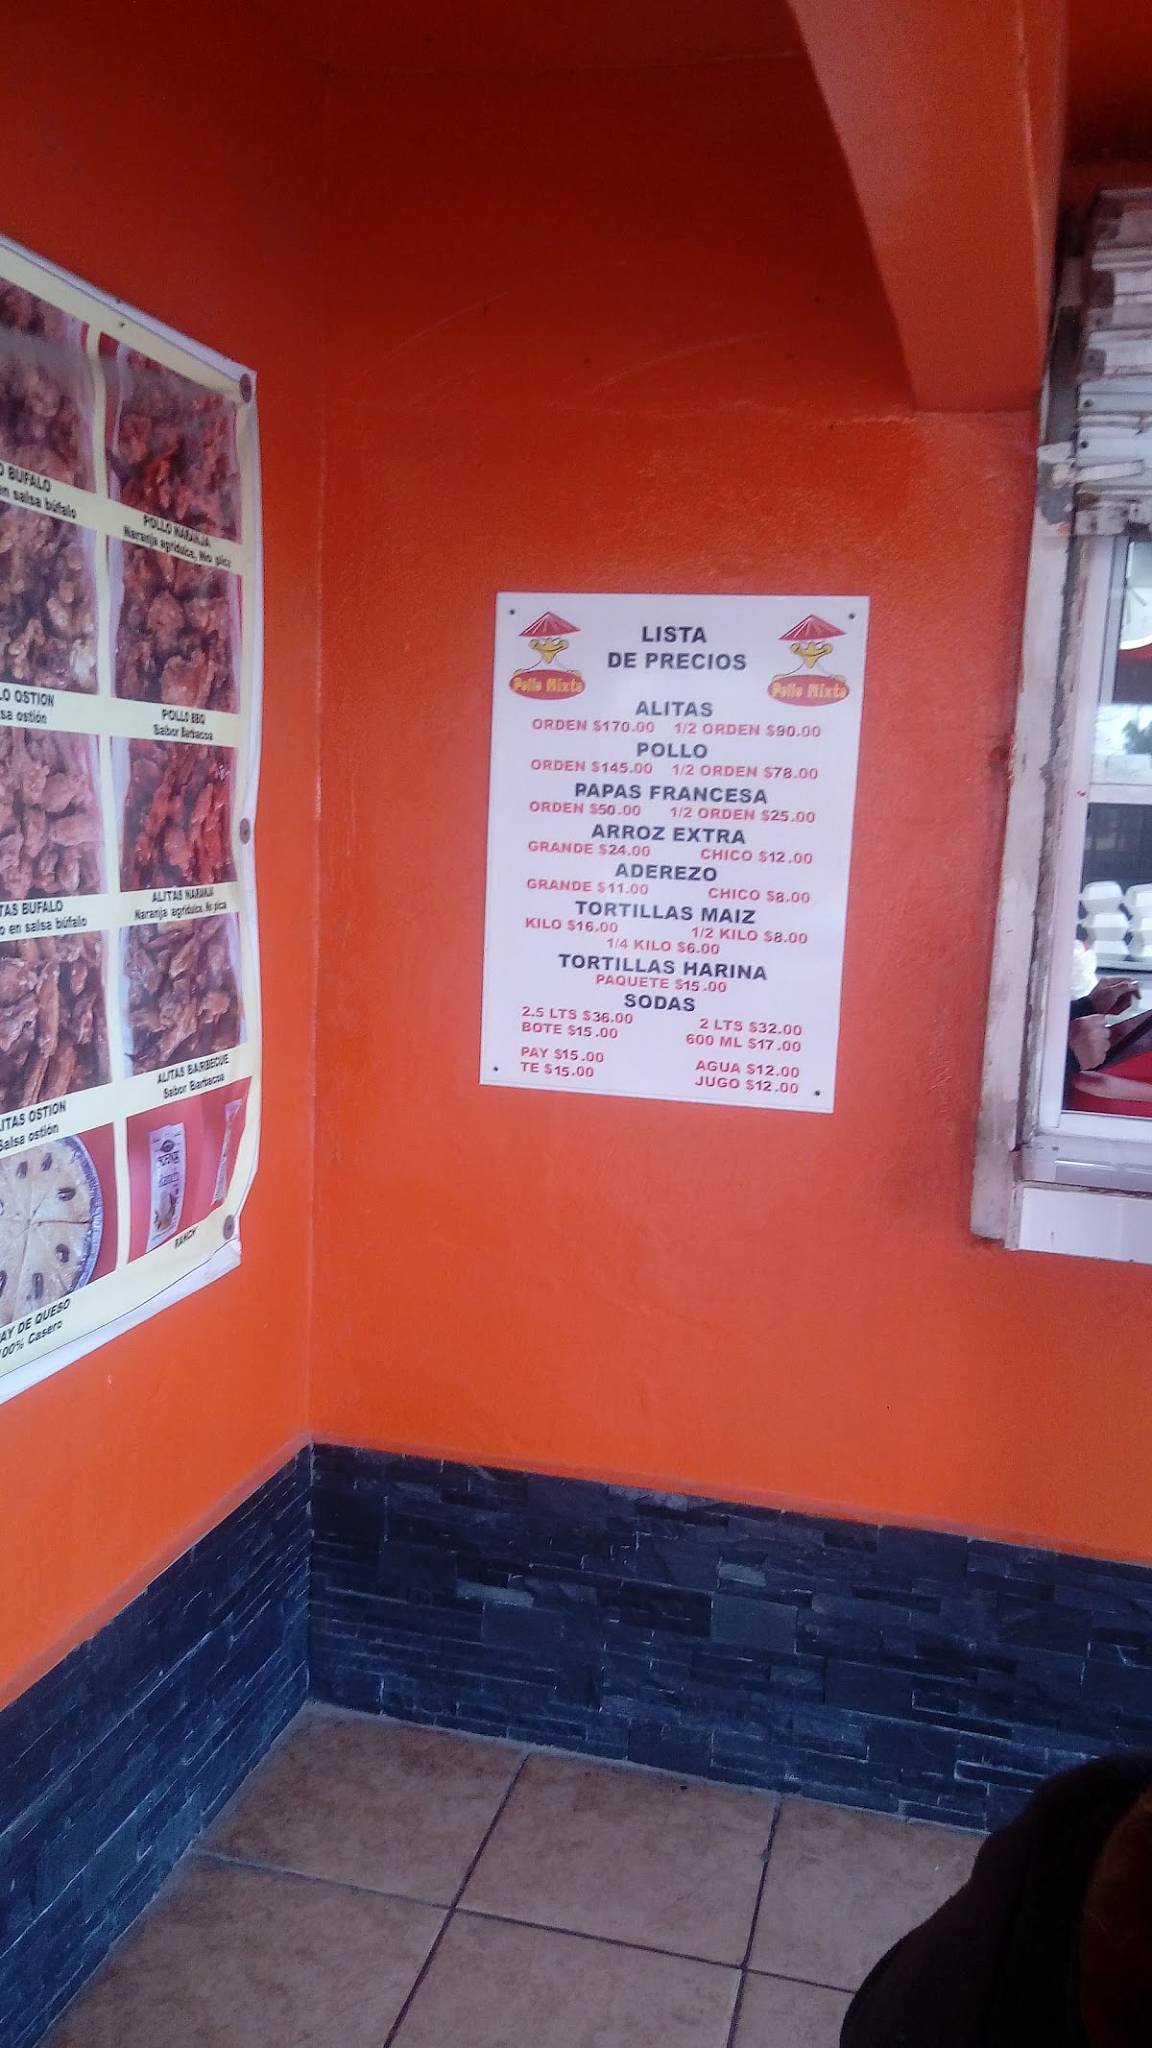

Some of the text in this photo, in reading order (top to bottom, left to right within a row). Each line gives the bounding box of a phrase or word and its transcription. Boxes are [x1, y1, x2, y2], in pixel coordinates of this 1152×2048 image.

[8, 465, 51, 492] BUFALO
[14, 488, 41, 506] salsa
[144, 512, 172, 533] POLLO
[642, 626, 707, 643] LISTA
[608, 652, 747, 670] DE PRECIOS
[15, 688, 54, 706] OSTION
[16, 708, 47, 722] ostión
[162, 707, 188, 721] POLLO
[636, 701, 713, 717] ALITAS
[153, 722, 180, 735] Sabor
[532, 719, 655, 734] ORDEN $170.00
[674, 722, 821, 738] 1/2 ORDEN $90.00
[637, 742, 708, 759] POLLO
[531, 759, 653, 775] ORDEN $145.00
[672, 764, 818, 780] 1/2 ORDEN $78.00
[575, 783, 767, 804] PAPAS FRANCESA
[529, 801, 641, 817] ORDEN $50.00
[671, 807, 816, 823] 1/2 ORDEN $25.00
[592, 824, 746, 844] ARROZ EXTRA
[528, 840, 651, 858] GRANDE $24.00
[701, 848, 813, 865] CHICO $12.00
[615, 862, 718, 882] ADEREZO
[152, 888, 182, 901] ALITAS
[527, 878, 649, 896] GRANDE $11.00
[708, 887, 811, 904] CHICO $8.00
[22, 898, 64, 913] BUFALO
[134, 904, 168, 919] Naranja
[575, 900, 756, 924] TORTILLAS MAIZ
[9, 922, 21, 933] en
[26, 918, 52, 931] salsa
[56, 913, 87, 928] búfalo
[526, 917, 618, 933] KILO $16.00
[692, 927, 808, 944] 1/2 KILO $8.00
[607, 938, 720, 955] 1/4 KILO $6.00
[559, 953, 767, 980] TORTILLAS HARINA
[596, 974, 727, 992] PAQUETE $15.00
[624, 993, 696, 1012] SODAS
[522, 1006, 633, 1024] 2.5 LTS $36.00
[522, 1022, 618, 1039] BOTE $15.00
[700, 1018, 802, 1036] 2 LTS $32.00
[686, 1033, 801, 1052] 600 ML $17.00
[521, 1047, 604, 1063] PAY $15.00
[157, 1064, 185, 1082] ALITAS
[521, 1062, 594, 1078] TE $15.00
[696, 1060, 800, 1078] AGUA $12.00
[164, 1083, 188, 1098] Sabor
[695, 1077, 799, 1095] JUGO $12.00
[29, 1098, 67, 1122] OSTION
[28, 1121, 59, 1141] ostión
[18, 1317, 32, 1335] DE
[34, 1298, 70, 1326] QUESO
[28, 1320, 63, 1345] Casero
